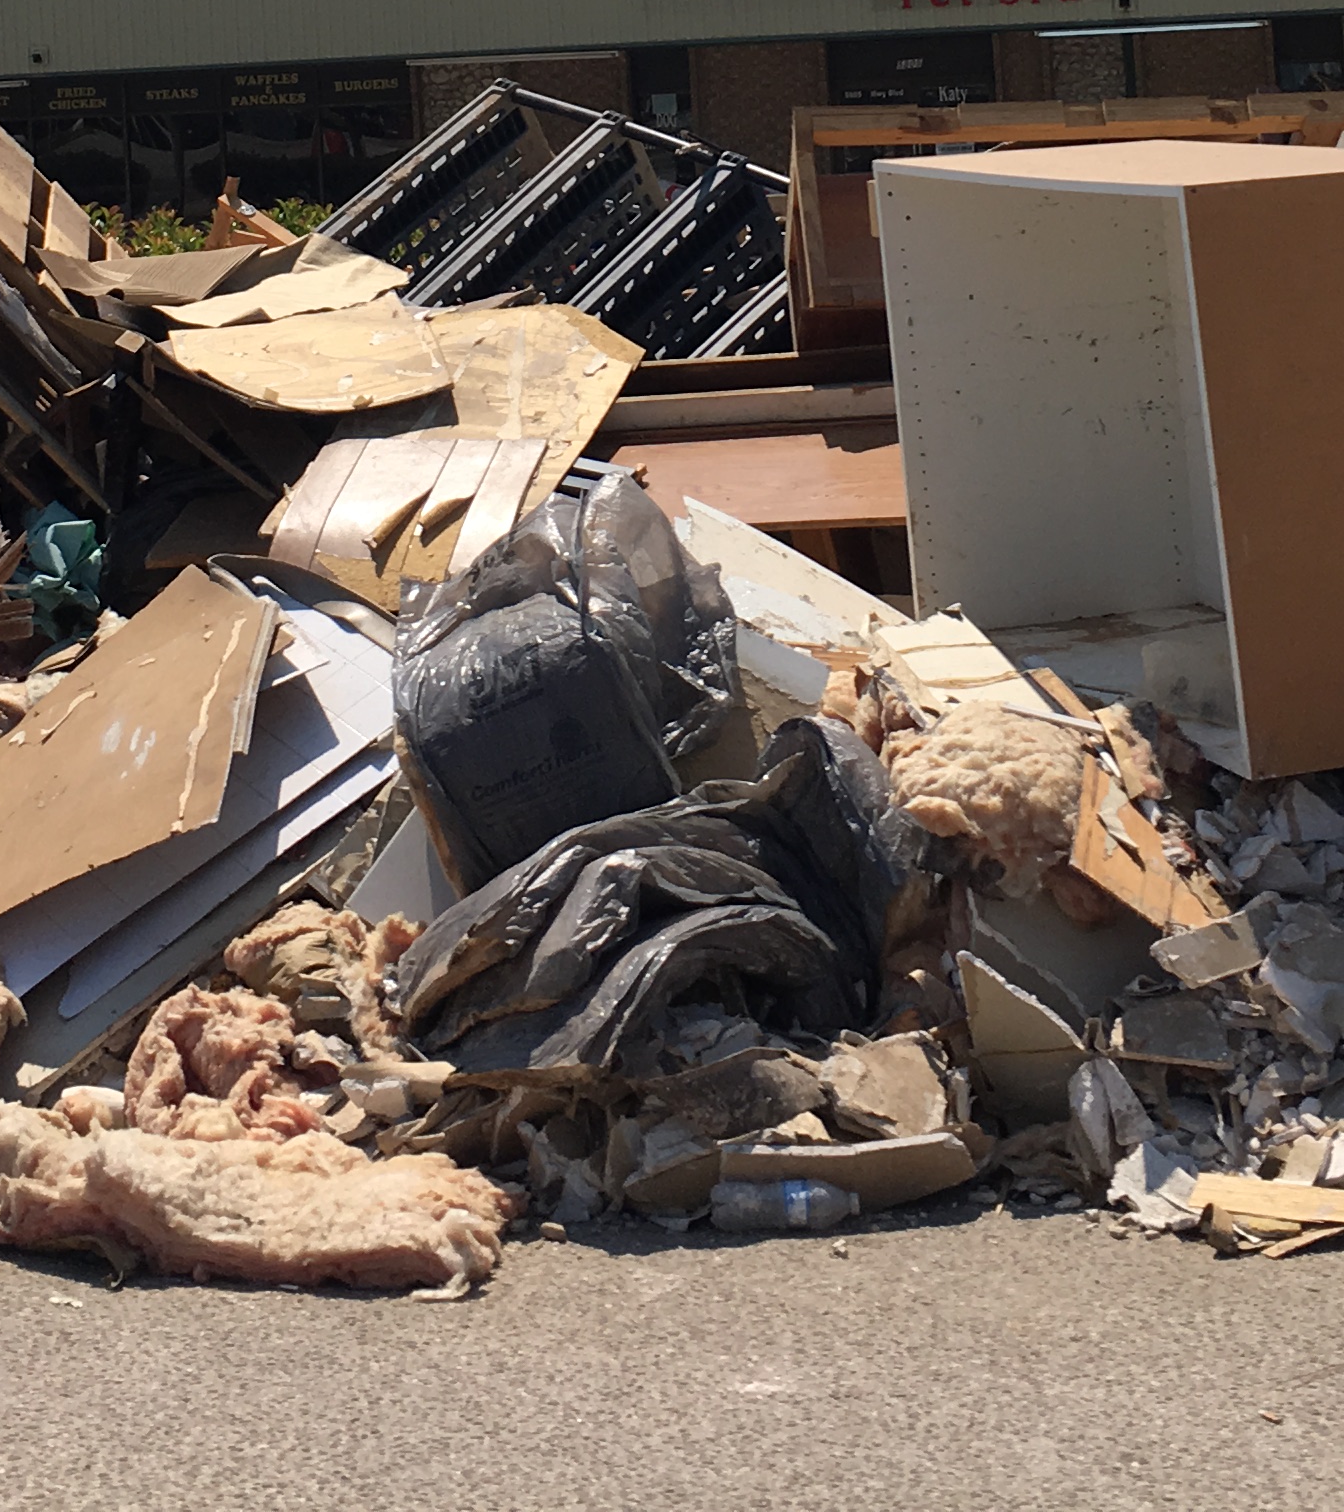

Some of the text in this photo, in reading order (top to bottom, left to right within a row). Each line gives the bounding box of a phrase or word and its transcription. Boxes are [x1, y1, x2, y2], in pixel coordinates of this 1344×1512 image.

[235, 73, 299, 86] WAFFLES
[334, 78, 399, 93] BURGERS
[57, 86, 96, 98] FRIED
[145, 88, 199, 101] STEAKS
[938, 86, 968, 103] Katy
[49, 98, 107, 110] CHICKEN
[231, 92, 306, 106] PANCAKES
